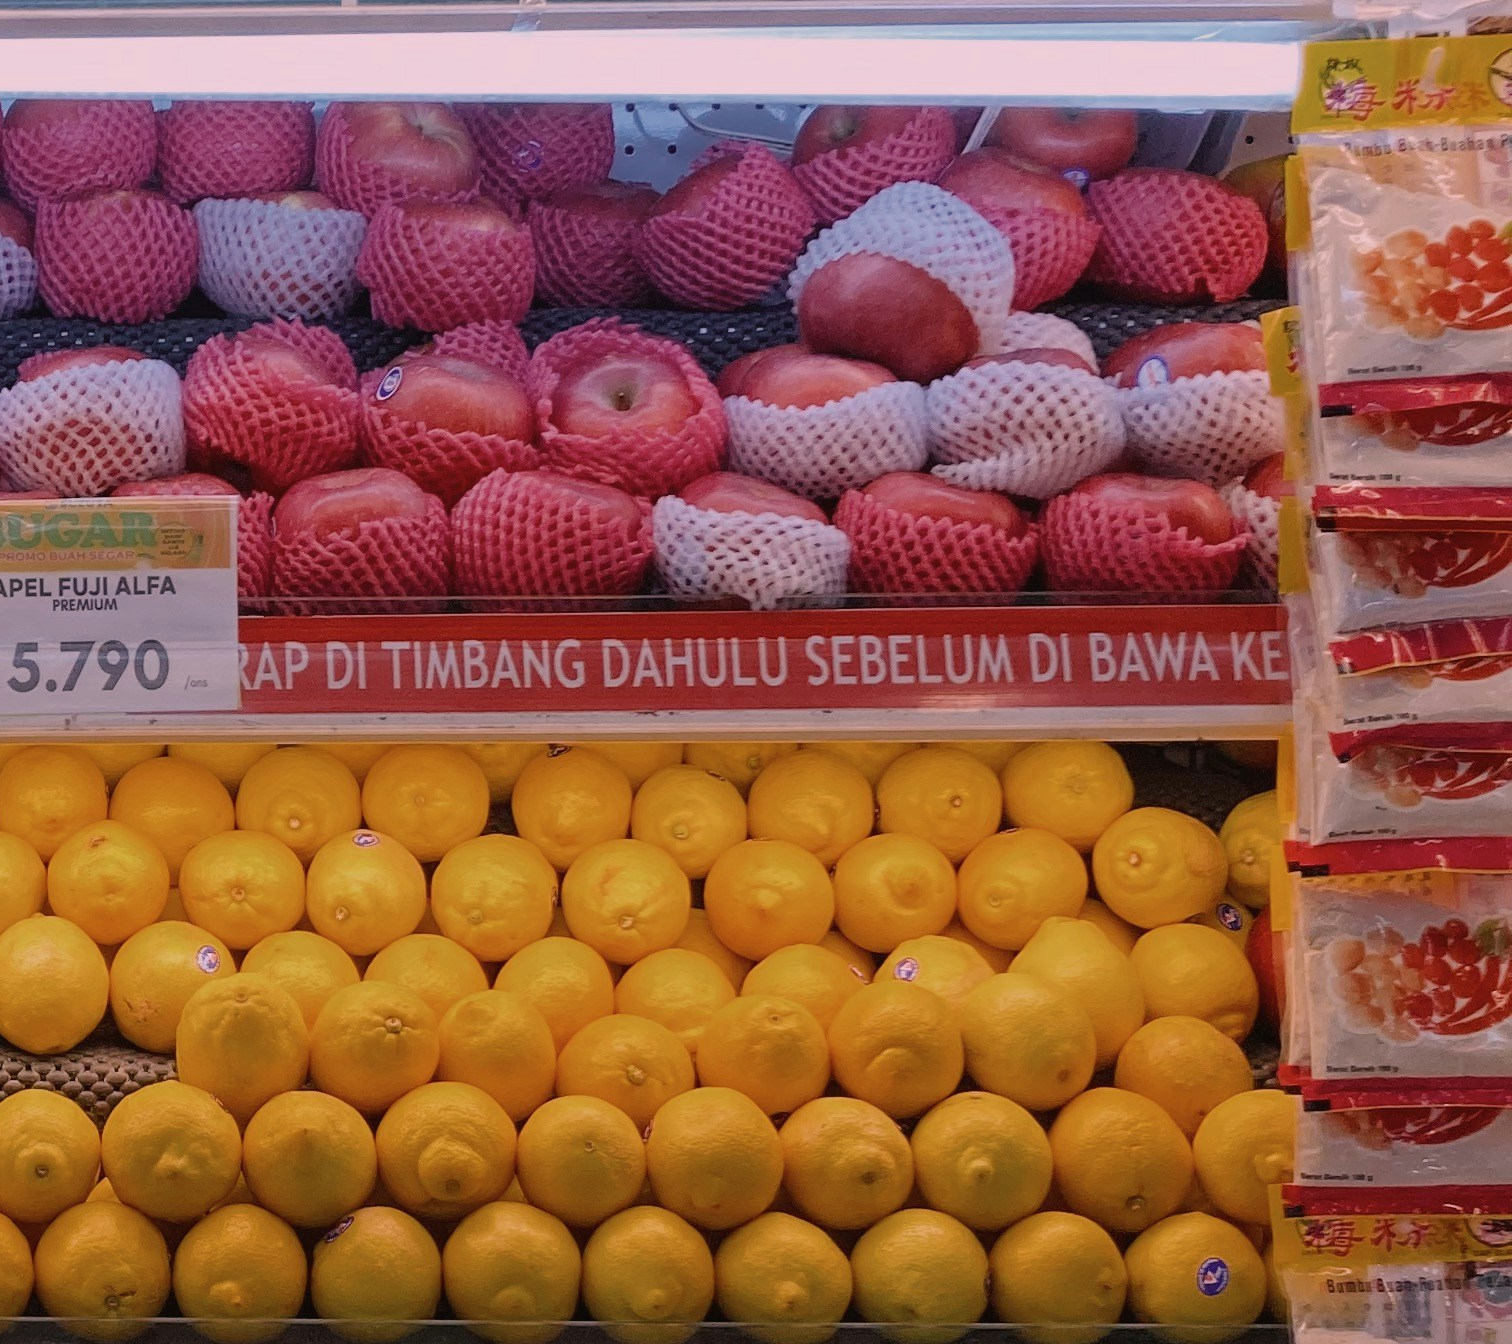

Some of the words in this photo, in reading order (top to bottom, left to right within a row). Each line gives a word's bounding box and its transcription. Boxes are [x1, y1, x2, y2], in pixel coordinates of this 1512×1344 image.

[49, 551, 88, 562] BUAH
[90, 550, 135, 561] SEGAR
[58, 577, 108, 597] FUJI
[115, 575, 177, 596] ALFA
[52, 598, 118, 612] PREMIUM
[7, 639, 170, 693] 5.790
[238, 642, 309, 691] RAP
[326, 641, 367, 690] DI
[381, 639, 586, 690] TIMBANG
[601, 637, 787, 688] DAHULU
[805, 633, 1015, 686] SEBELUM
[1028, 633, 1072, 684] DI
[1089, 631, 1219, 684] BAWA
[1229, 630, 1289, 681] KE
